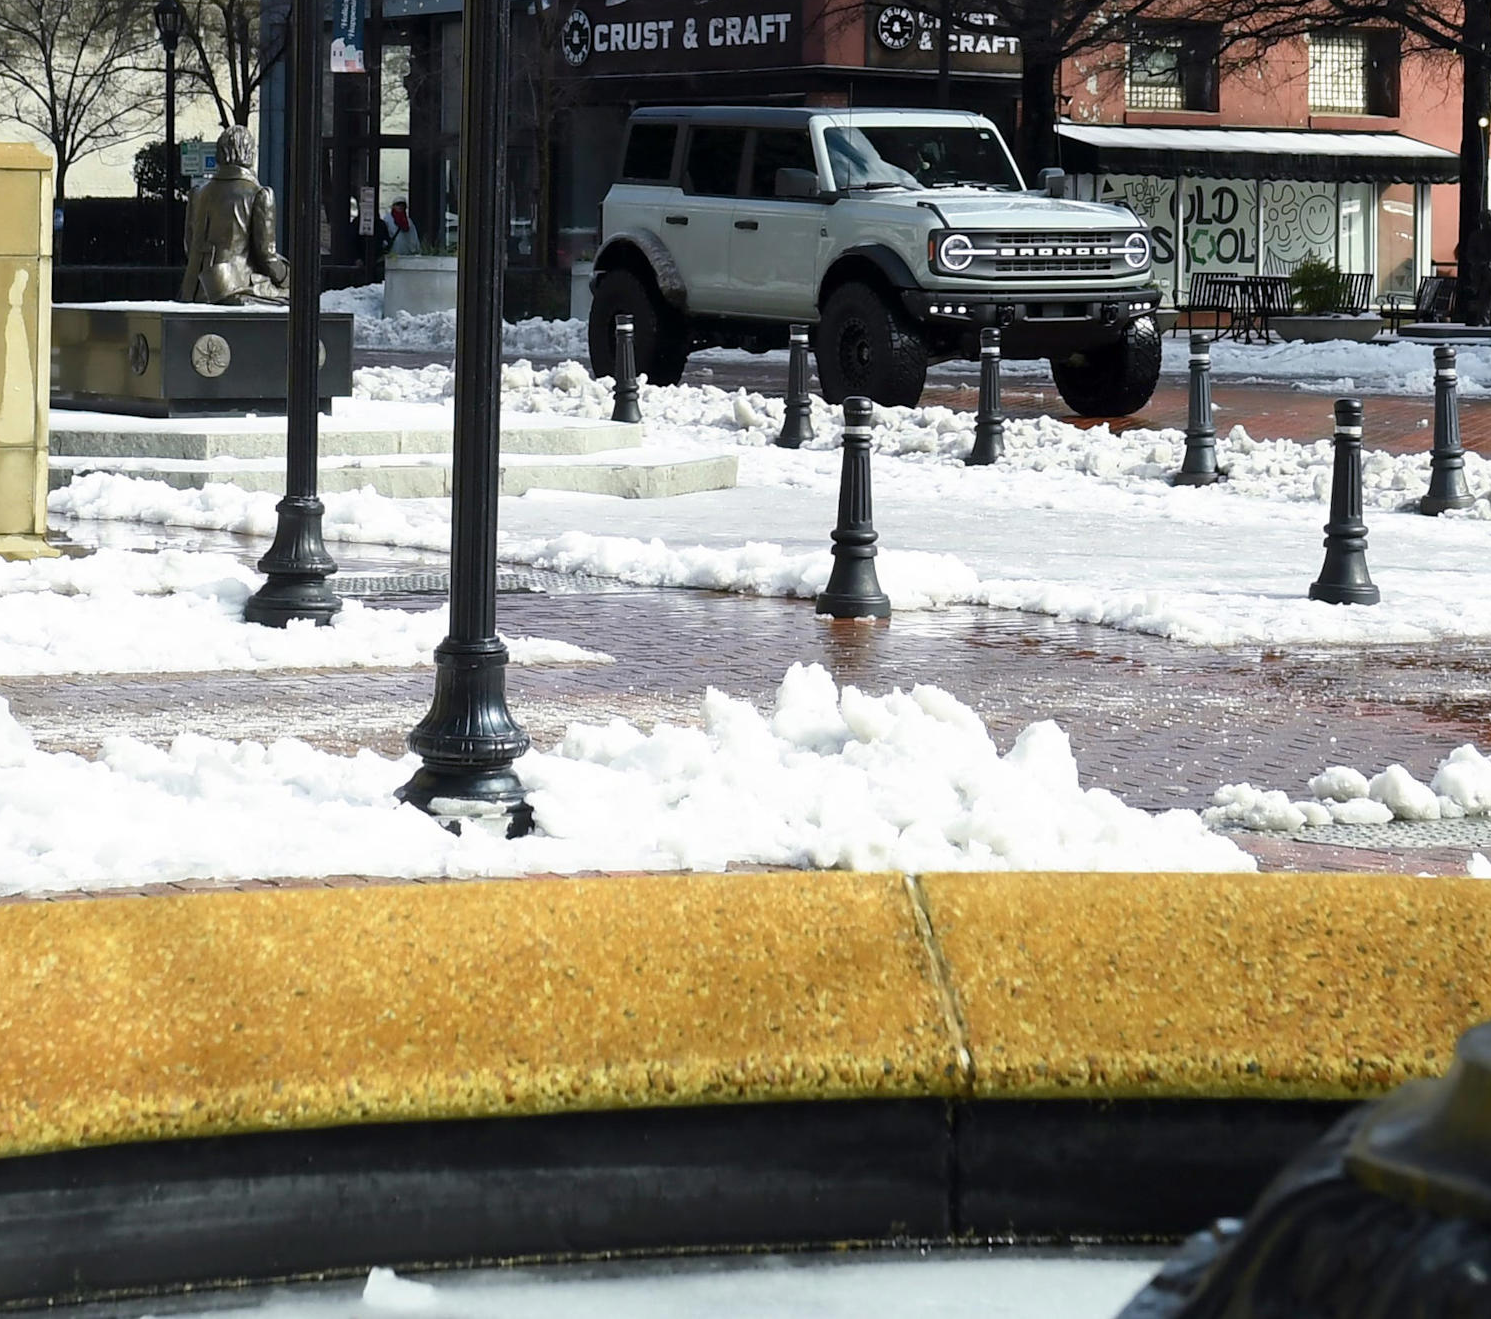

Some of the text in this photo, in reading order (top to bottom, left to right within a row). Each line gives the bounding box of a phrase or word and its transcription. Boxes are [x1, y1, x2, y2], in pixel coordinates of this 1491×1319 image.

[881, 7, 914, 23] CRUST
[594, 13, 791, 52] CRUST & CRAFT
[892, 21, 901, 33] &
[881, 31, 912, 47] CRAFT
[918, 31, 1020, 55] & CRAFT
[1169, 185, 1239, 225] OLD
[1000, 246, 1109, 256] BRONCO
